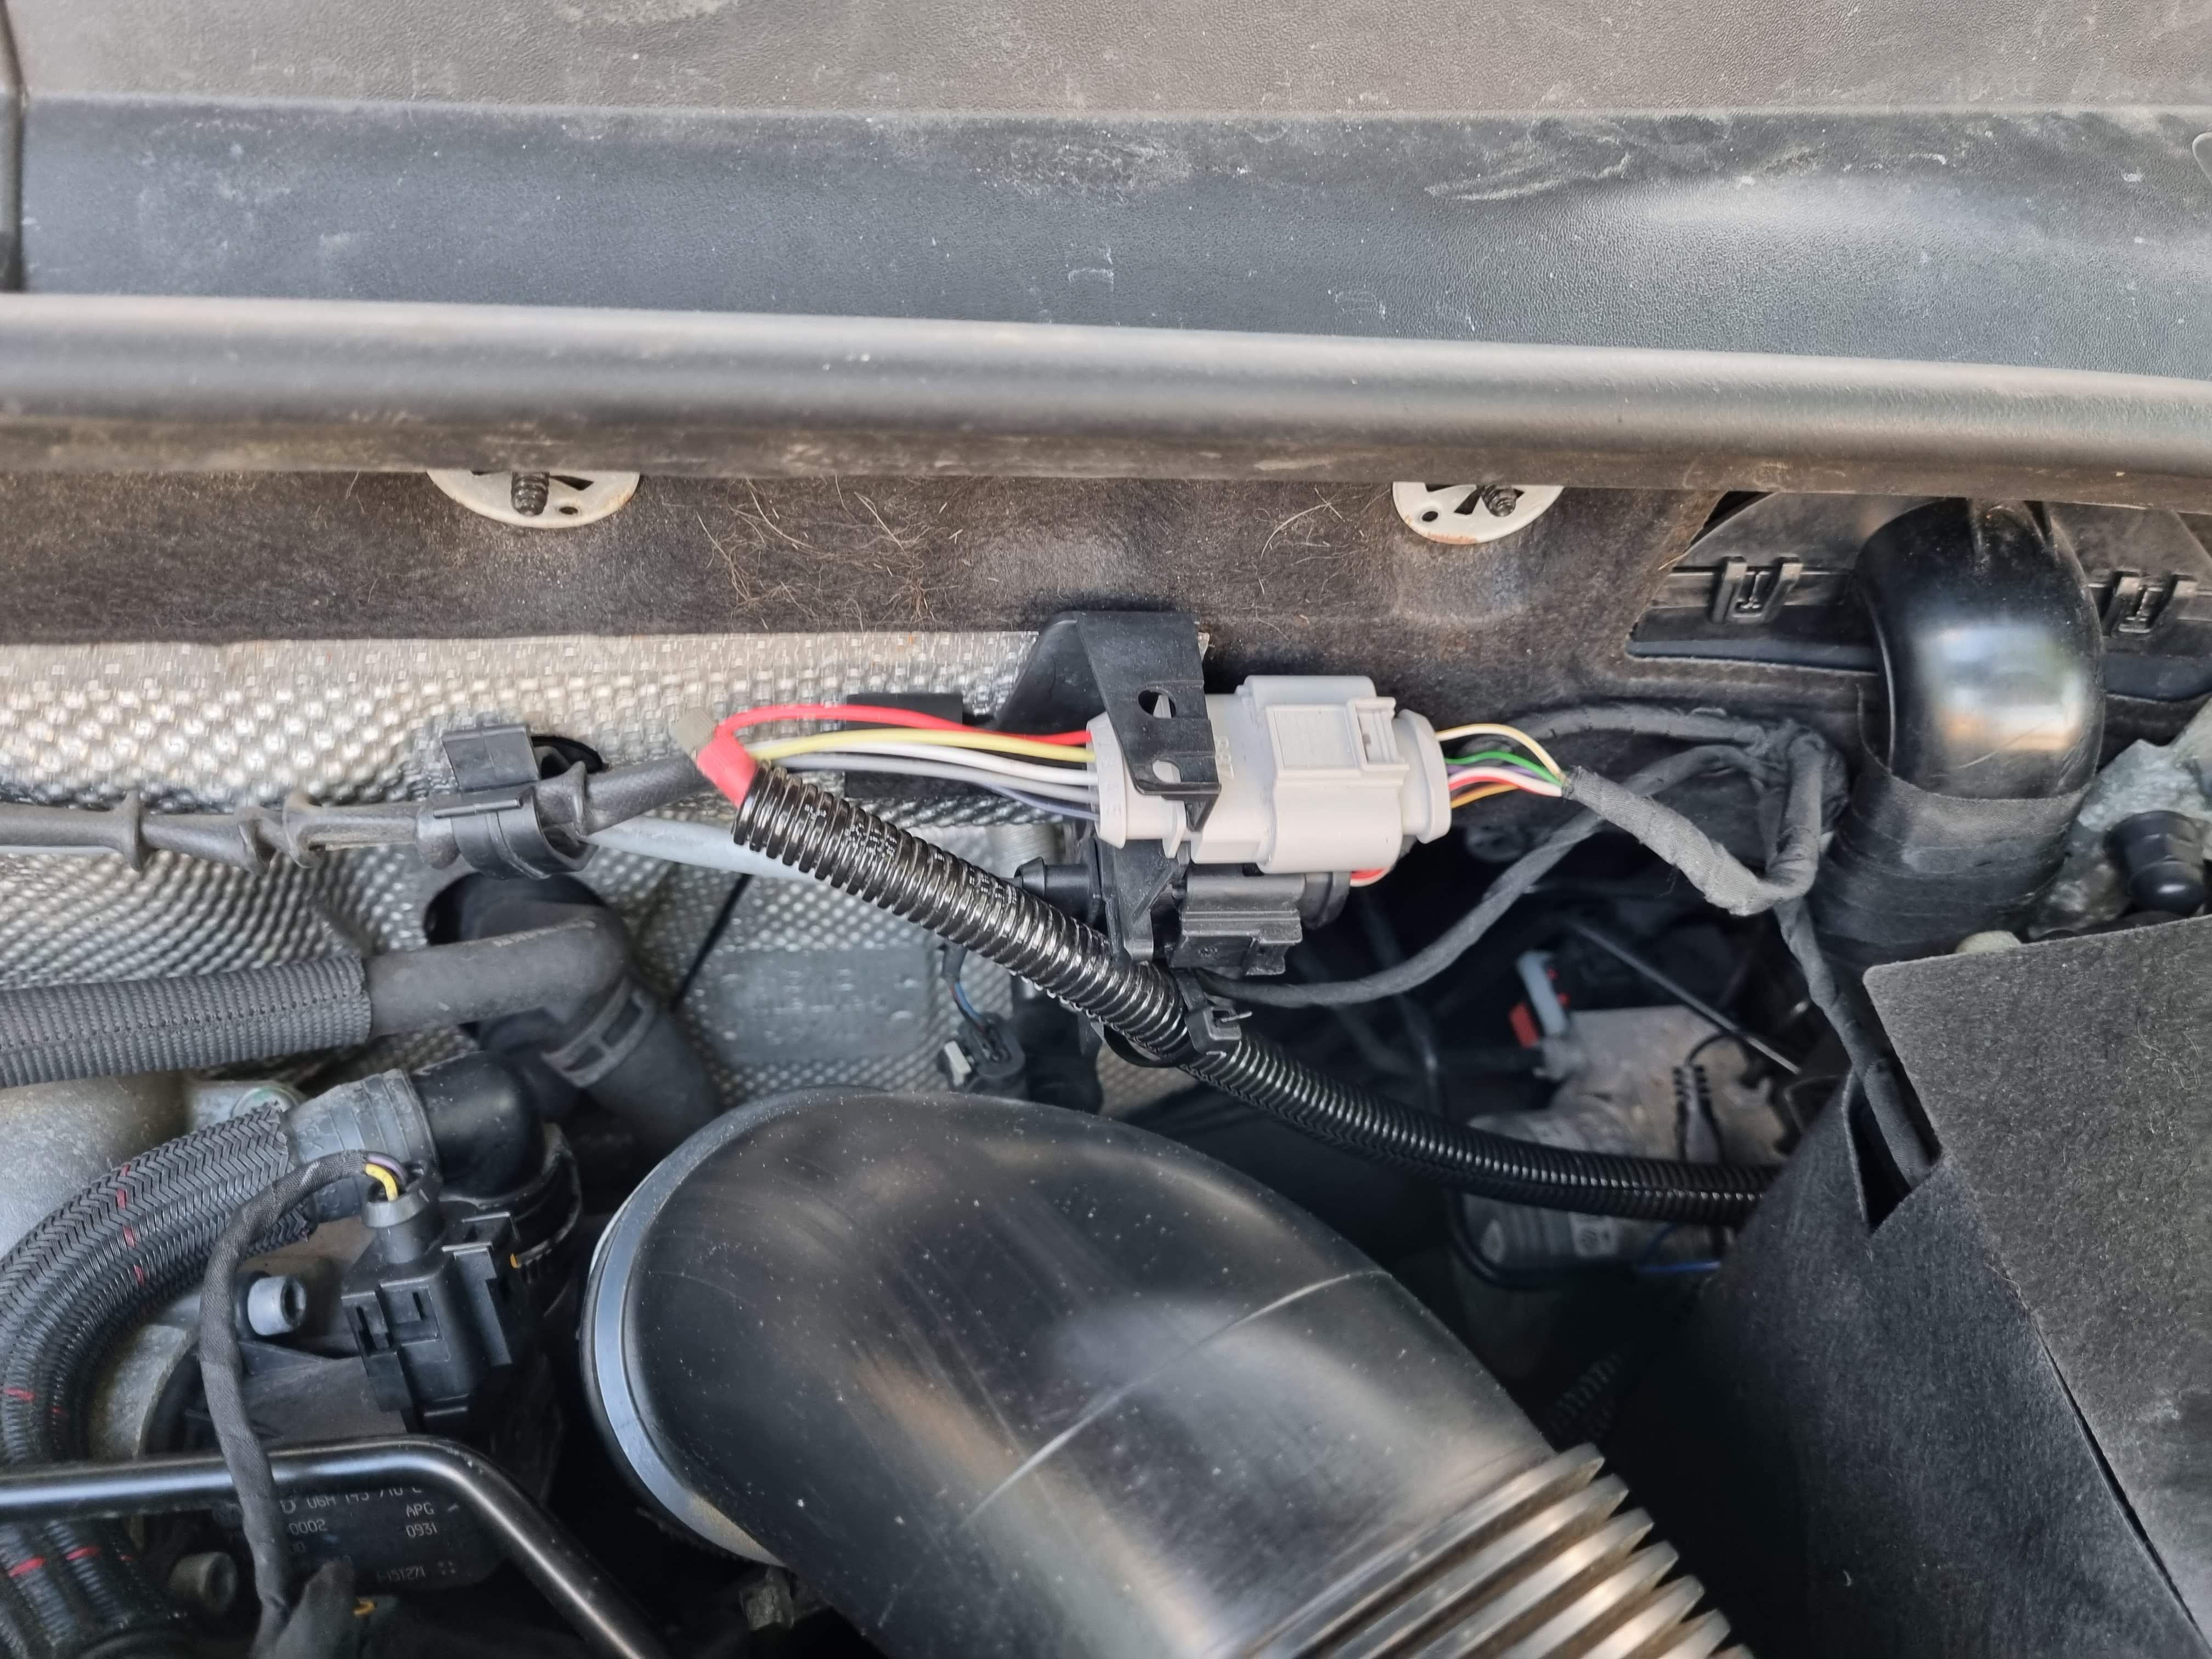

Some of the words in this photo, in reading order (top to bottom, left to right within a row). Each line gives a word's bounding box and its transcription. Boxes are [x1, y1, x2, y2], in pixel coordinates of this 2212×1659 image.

[405, 1502, 435, 1517] APG
[289, 1518, 327, 1536] 0002
[405, 1521, 438, 1538] 0931
